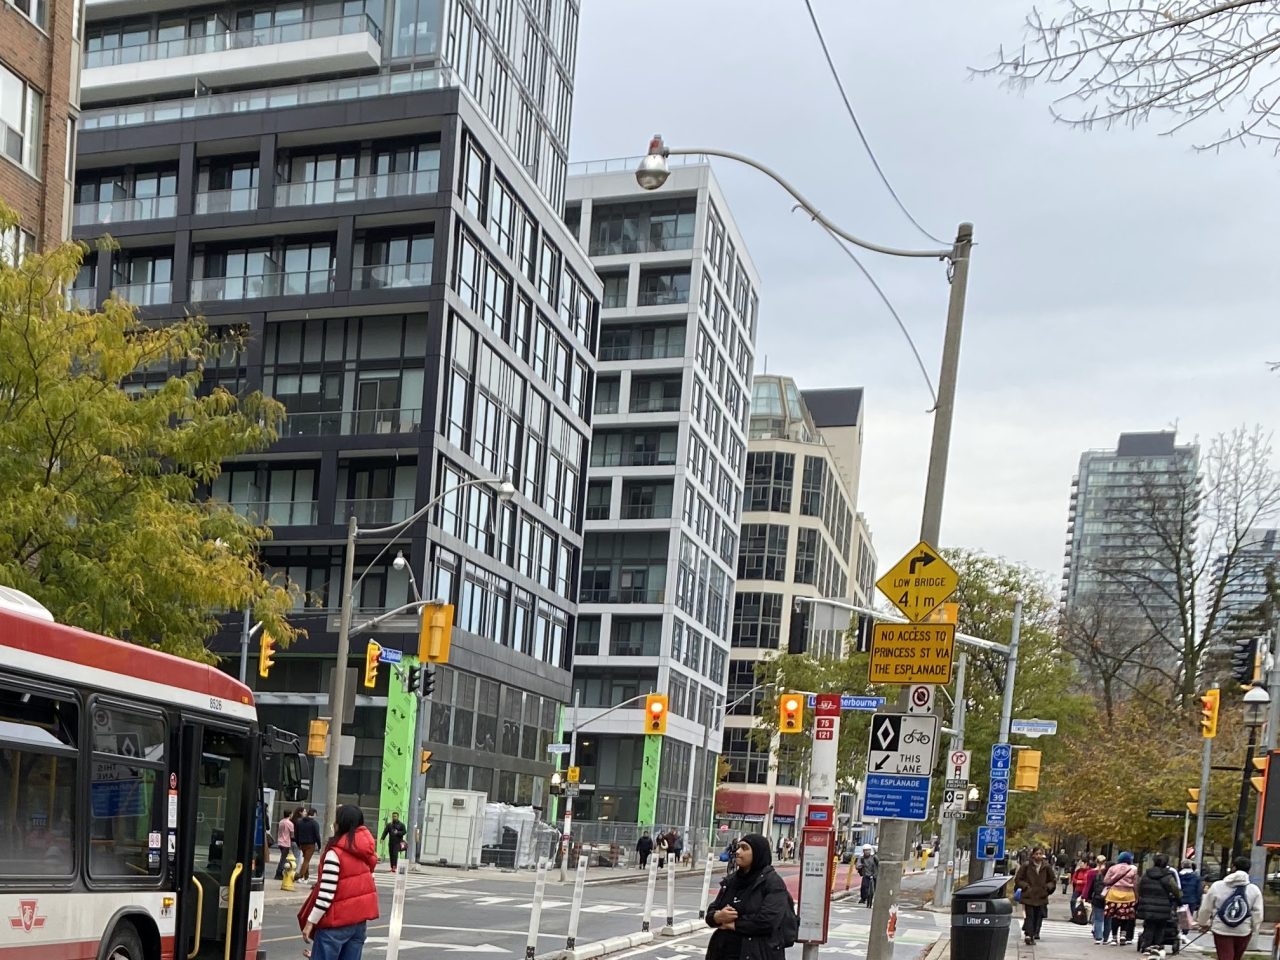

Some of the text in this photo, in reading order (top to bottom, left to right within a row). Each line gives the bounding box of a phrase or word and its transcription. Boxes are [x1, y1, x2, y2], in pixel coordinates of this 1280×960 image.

[894, 577, 945, 587] LOW BRIDGE
[924, 596, 935, 607] m
[882, 630, 946, 641] NO ACCESS TO
[874, 647, 949, 658] PRINCESS ST VIA
[875, 663, 947, 675] THE ESPLANADE
[841, 699, 877, 707] herbourne
[900, 754, 921, 763] THIS
[896, 764, 922, 773] LANE
[997, 760, 1004, 768] 6
[880, 779, 920, 787] ESPLANADE
[966, 916, 981, 925] Litter
